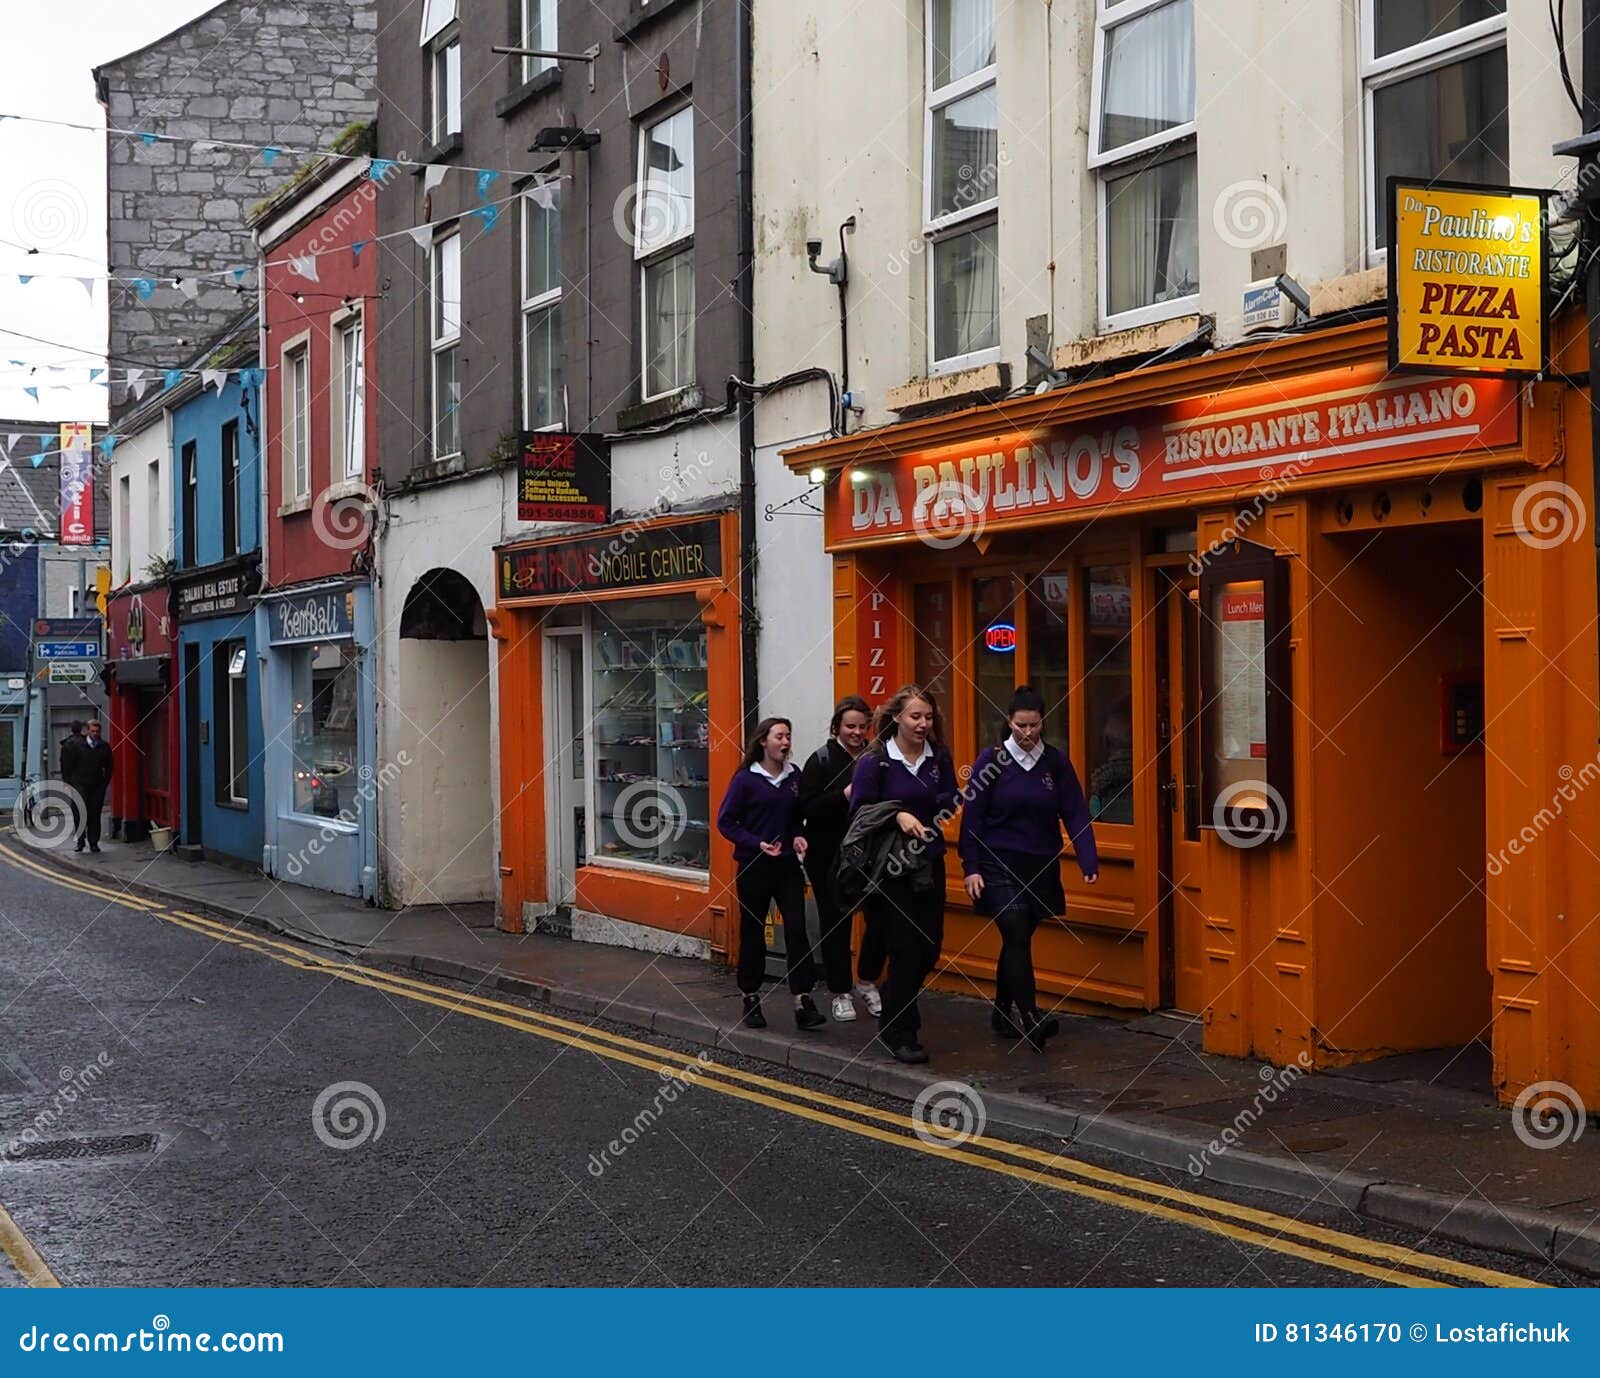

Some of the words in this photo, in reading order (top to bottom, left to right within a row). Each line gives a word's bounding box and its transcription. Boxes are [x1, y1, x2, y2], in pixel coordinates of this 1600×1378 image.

[1404, 196, 1423, 213] Da
[1421, 205, 1532, 243] Paulino's
[1412, 248, 1530, 278] RISTORANTE
[1419, 281, 1520, 319] PIZZA
[1416, 322, 1524, 360] PASTA
[1163, 410, 1320, 465] RISTORANTE
[1327, 382, 1476, 439] ITALIANO
[851, 470, 903, 532] DA
[913, 425, 1141, 522] PAULINO'S
[601, 550, 648, 583] MOBILE
[651, 544, 704, 577] CENTER
[204, 582, 218, 598] REAL
[218, 577, 239, 596] ESTATE
[1227, 602, 1248, 615] Lunch
[1249, 601, 1264, 614] Men
[86, 644, 96, 656] P
[870, 592, 886, 697] PIZZ
[985, 627, 1016, 648] OPEN
